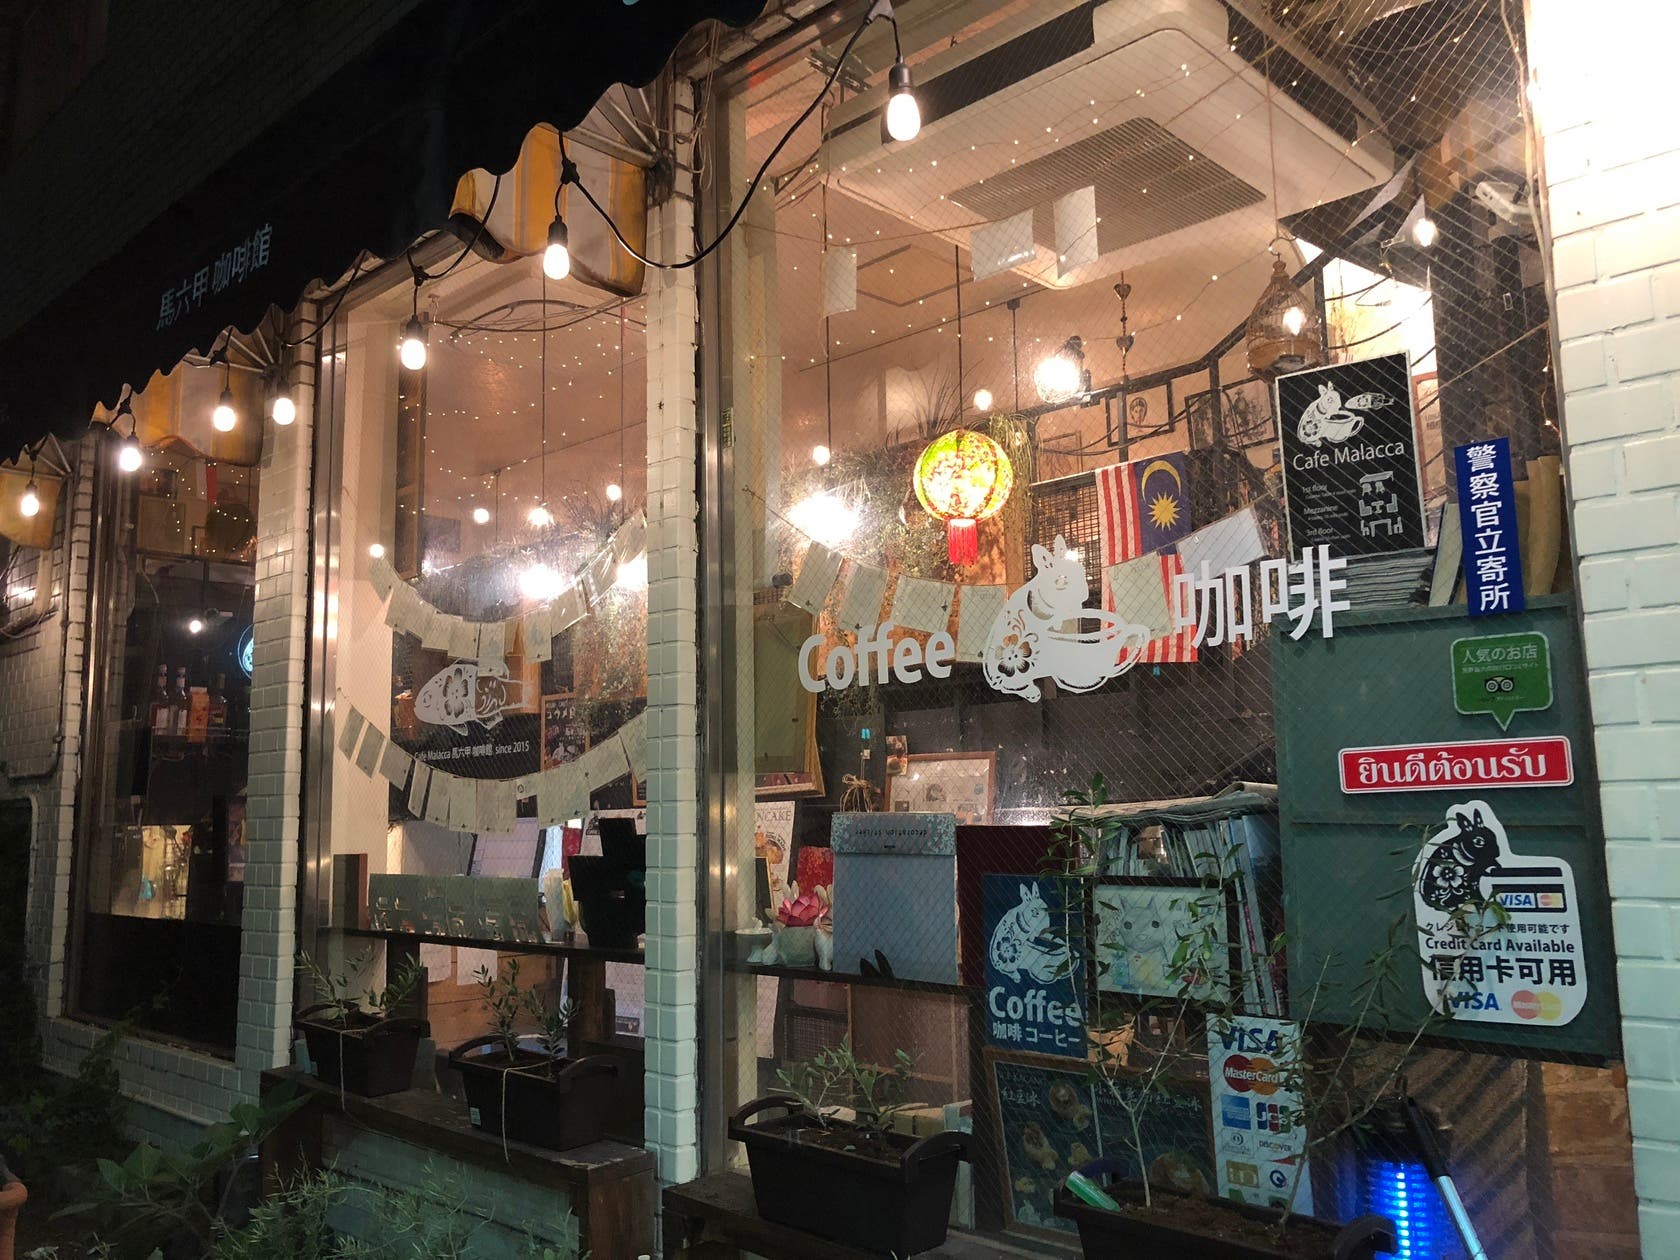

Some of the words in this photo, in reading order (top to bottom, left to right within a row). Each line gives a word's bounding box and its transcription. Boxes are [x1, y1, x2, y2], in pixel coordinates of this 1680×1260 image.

[156, 265, 210, 331] 馬六甲
[211, 222, 273, 294] 咖啡館
[1292, 450, 1330, 470] Cafe
[1334, 441, 1405, 465] Malacca
[1303, 505, 1339, 515] Mezzanine
[1306, 528, 1317, 537] 3rd
[1318, 527, 1334, 535] floor
[1466, 443, 1511, 612] 警察官立寄所
[1172, 543, 1350, 649] 咖啡
[798, 622, 954, 694] Coffee
[1461, 643, 1539, 664] 人気のお店
[427, 749, 451, 761] Malacca
[451, 747, 472, 759] 馬六甲
[495, 744, 512, 755] since
[512, 740, 530, 754] 2015
[1358, 747, 1547, 785] ยินดีต้อนรับ
[755, 810, 792, 822] NCAKE
[1500, 893, 1534, 906] VISA
[1425, 937, 1468, 950] Credit
[1471, 938, 1501, 951] Card
[1506, 938, 1575, 953] Available
[1430, 954, 1577, 987] 信用卡可用
[988, 985, 1083, 1027] Coffee
[1451, 991, 1501, 1011] VISA
[992, 1021, 1023, 1042] 咖啡
[1025, 1027, 1081, 1048] コーヒー
[1224, 1067, 1279, 1083] MasterCard
